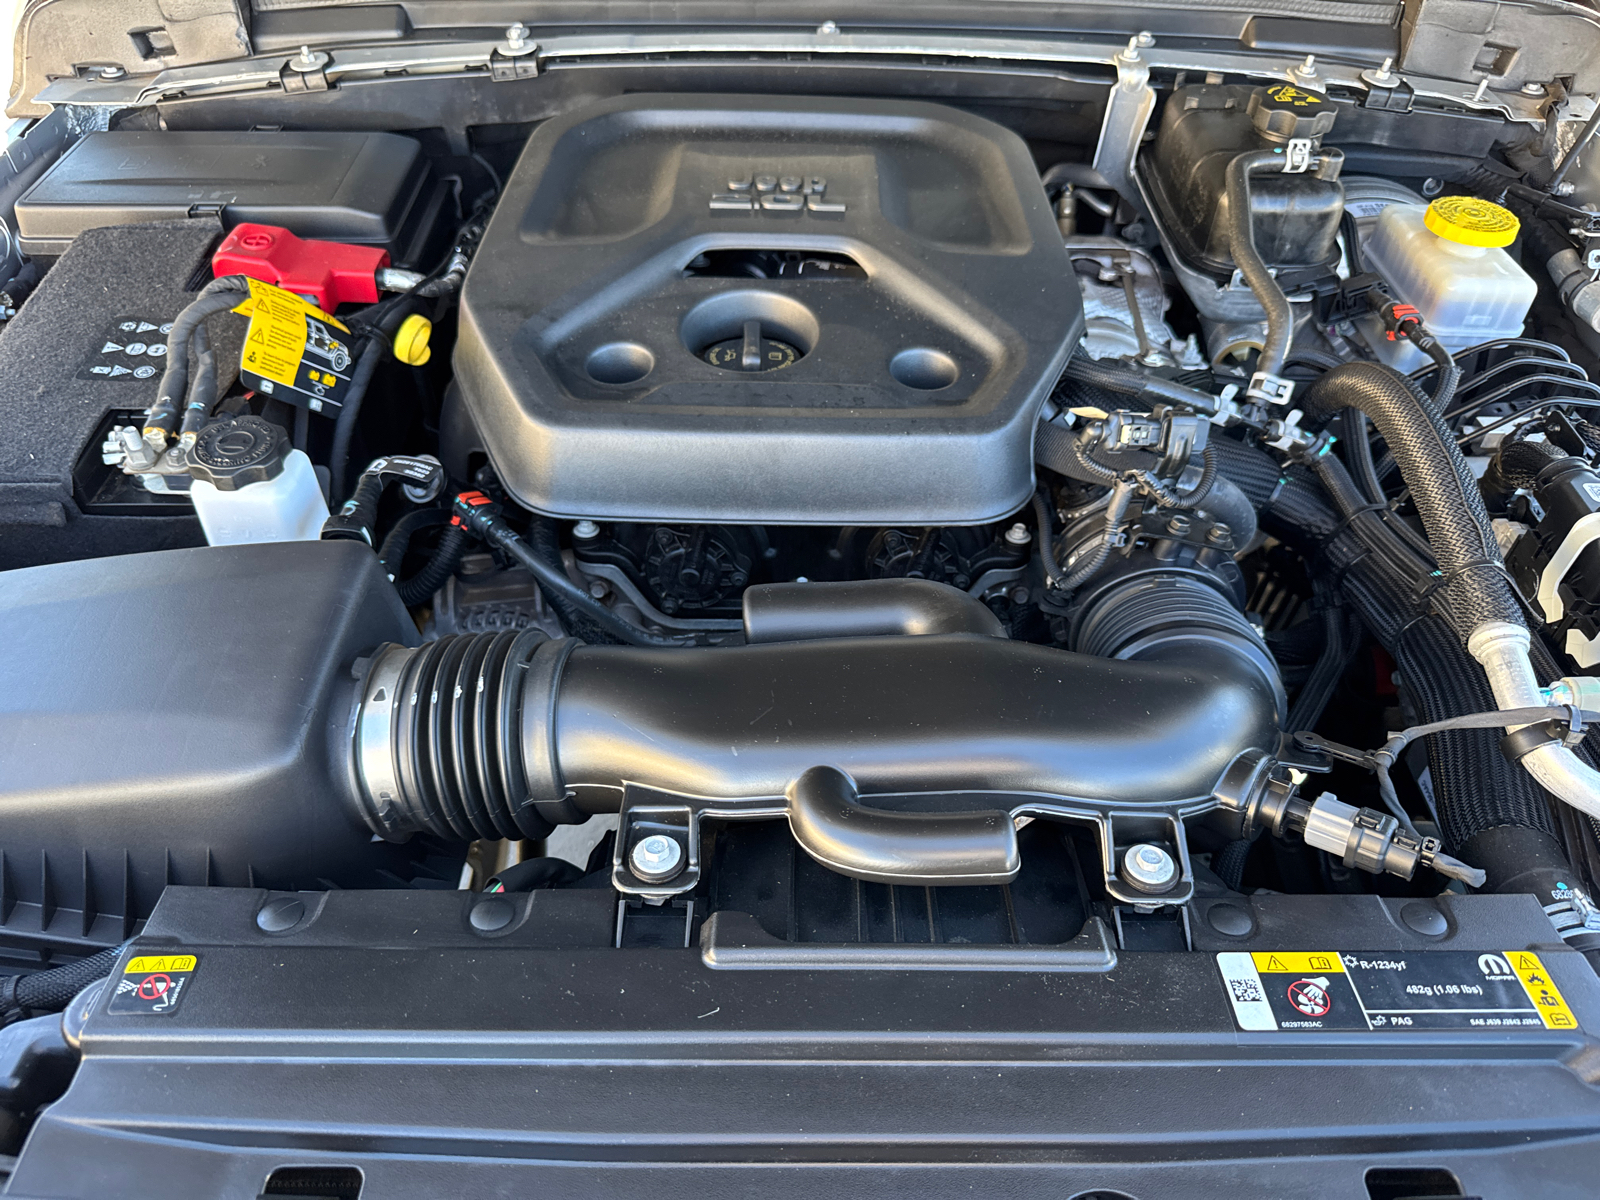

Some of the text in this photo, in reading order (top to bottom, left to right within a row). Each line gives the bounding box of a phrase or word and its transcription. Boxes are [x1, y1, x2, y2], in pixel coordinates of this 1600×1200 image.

[728, 174, 827, 195] Jeep
[708, 193, 847, 212] 2.0L
[1359, 960, 1407, 971] R-1234yf
[1405, 984, 1483, 996] 482g (1.06 lbs)
[1390, 1016, 1413, 1026] PAG
